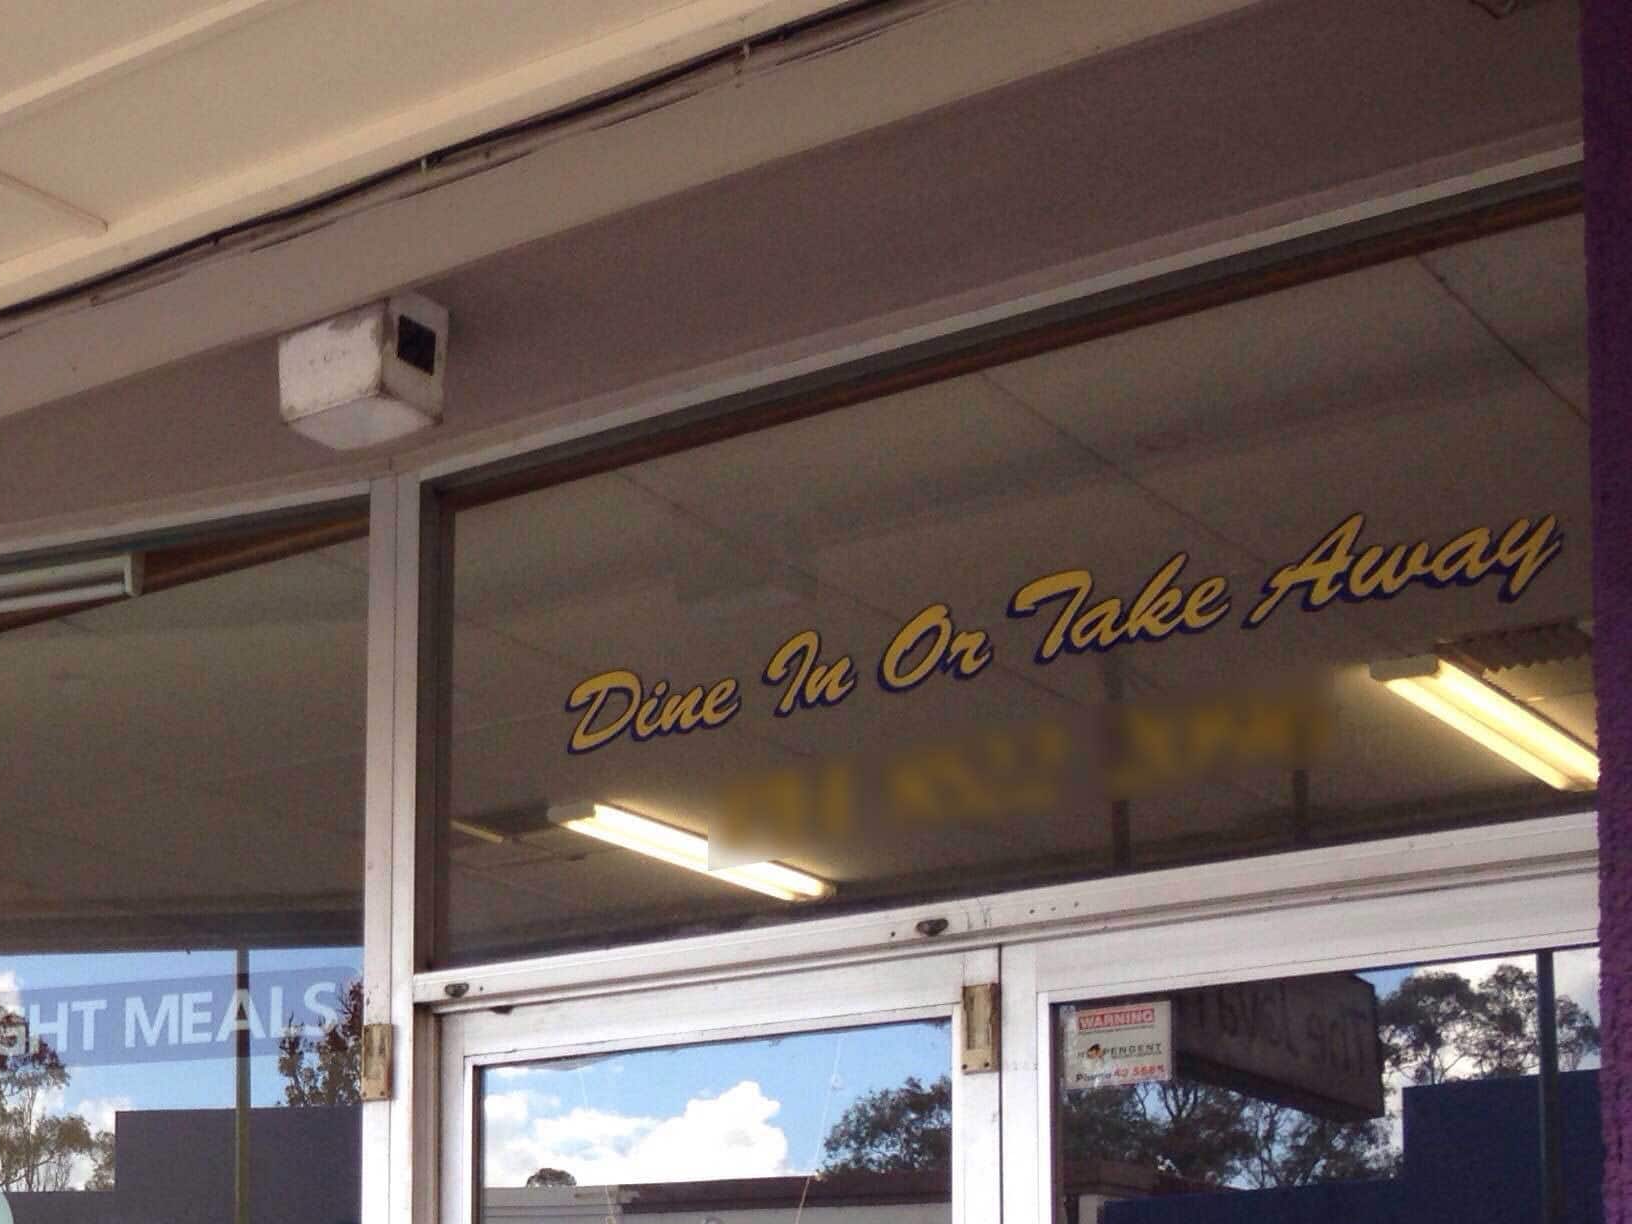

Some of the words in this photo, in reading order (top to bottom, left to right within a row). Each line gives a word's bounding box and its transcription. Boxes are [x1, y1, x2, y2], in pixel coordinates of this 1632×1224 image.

[566, 668, 741, 755] Dine
[765, 629, 858, 718] In
[876, 603, 995, 692] Or
[1004, 552, 1230, 660] Take
[1248, 512, 1562, 624] Away
[123, 982, 340, 1049] MEALS
[1078, 1009, 1154, 1029] WARNING
